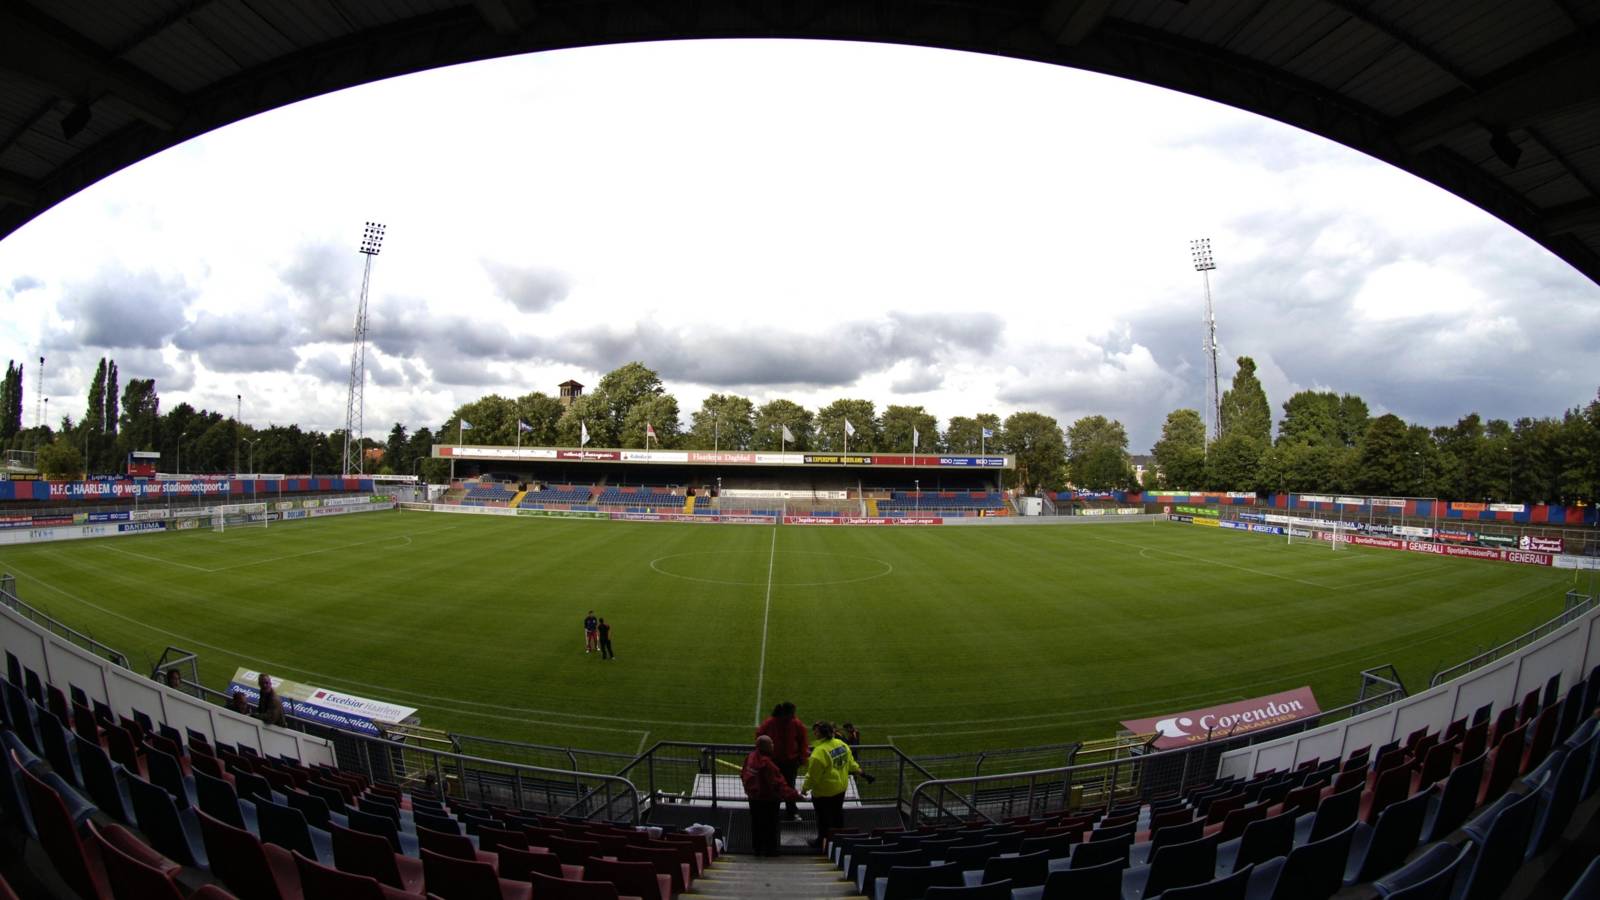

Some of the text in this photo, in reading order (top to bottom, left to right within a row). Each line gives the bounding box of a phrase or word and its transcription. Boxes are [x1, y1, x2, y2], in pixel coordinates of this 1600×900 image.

[73, 483, 110, 495] HAARLEM
[112, 484, 123, 496] op
[124, 484, 141, 496] weg
[143, 483, 161, 493] naar
[1409, 542, 1443, 554] GENERALI
[1508, 553, 1547, 565] GENERALI
[326, 694, 363, 708] Excelsior
[364, 702, 401, 716] Haarlem
[1199, 699, 1304, 731] Corendon
